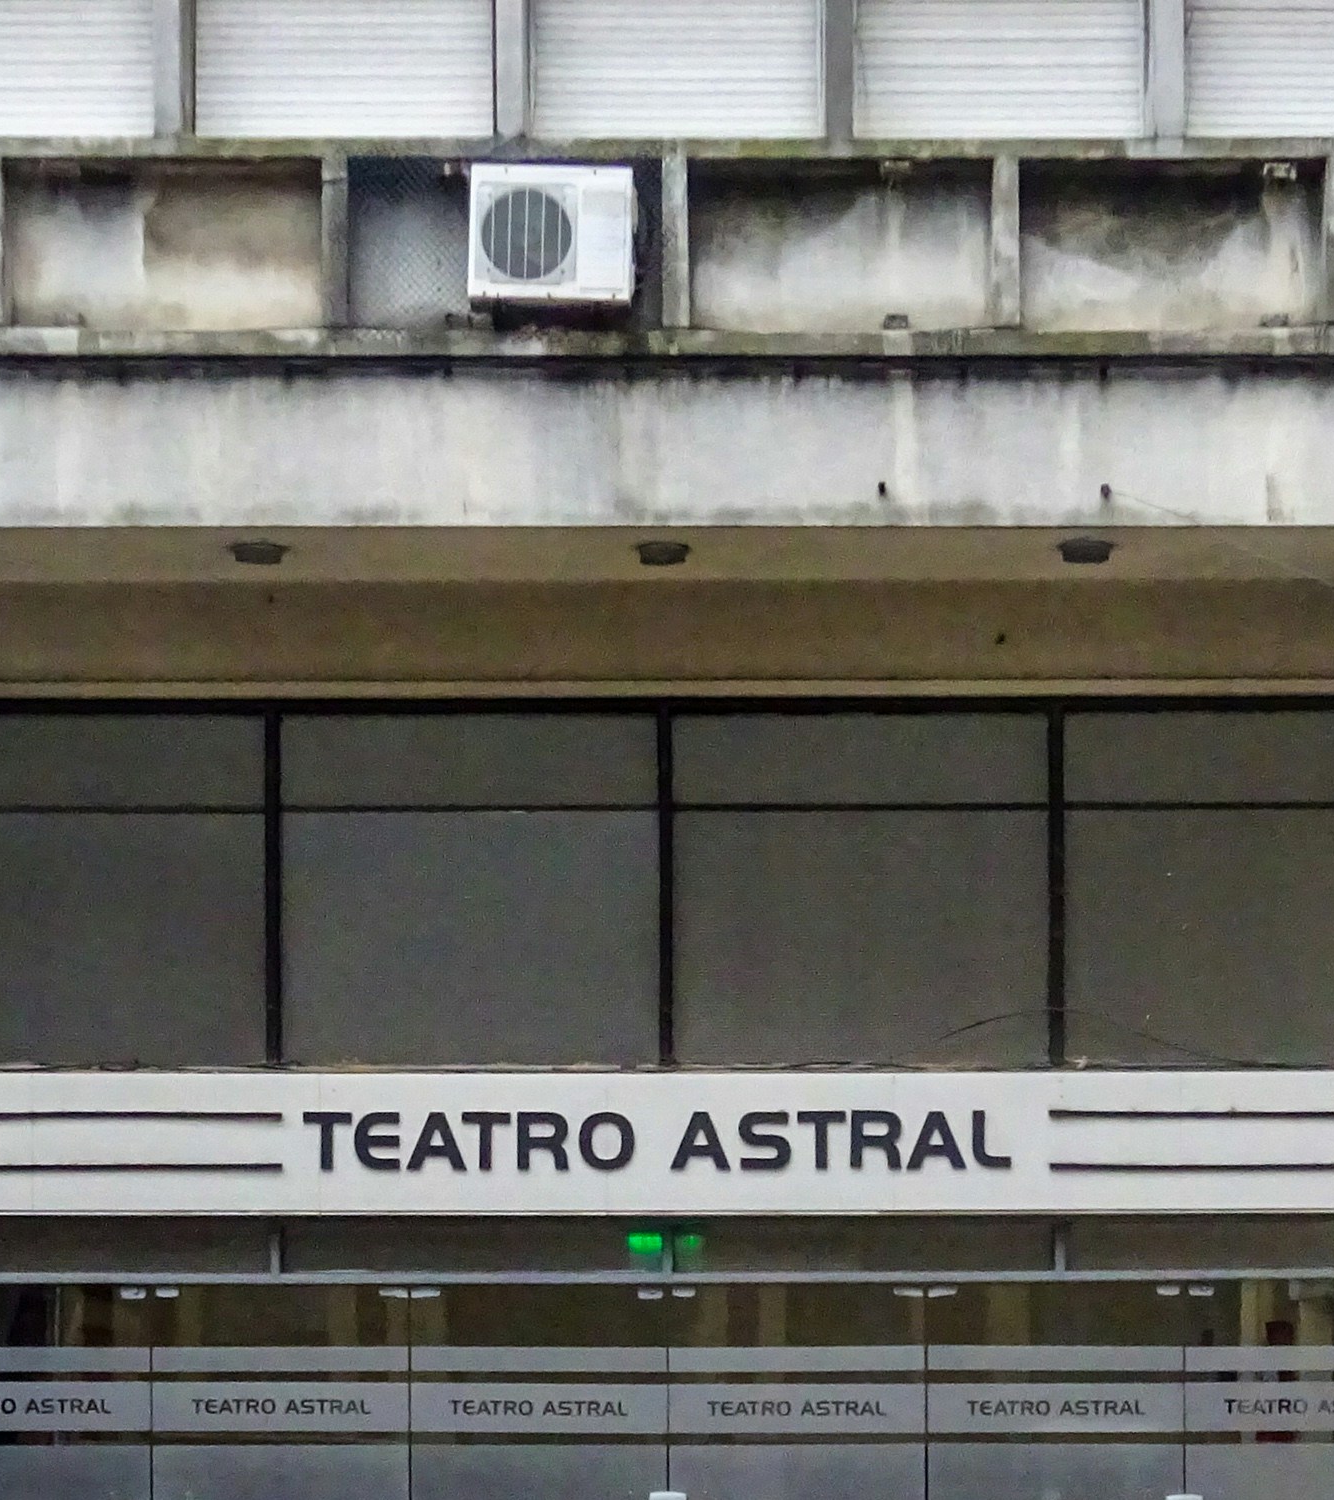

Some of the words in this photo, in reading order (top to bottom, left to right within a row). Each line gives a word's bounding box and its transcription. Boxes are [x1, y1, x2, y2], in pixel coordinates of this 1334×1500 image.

[302, 1111, 635, 1172] TEATRO
[670, 1109, 1012, 1171] ASTRAL
[24, 1398, 112, 1415] ASTRAL
[191, 1398, 277, 1415] TEATRO
[284, 1398, 371, 1415] ASTRAL
[448, 1399, 534, 1417] TEATRO
[542, 1400, 628, 1417] ASTRAL
[706, 1400, 792, 1417] TEATRO
[800, 1400, 887, 1417] ASTRAL
[966, 1399, 1051, 1417] TEATRO
[1059, 1399, 1145, 1416] ASTRAL
[1223, 1398, 1308, 1415] TEATRO
